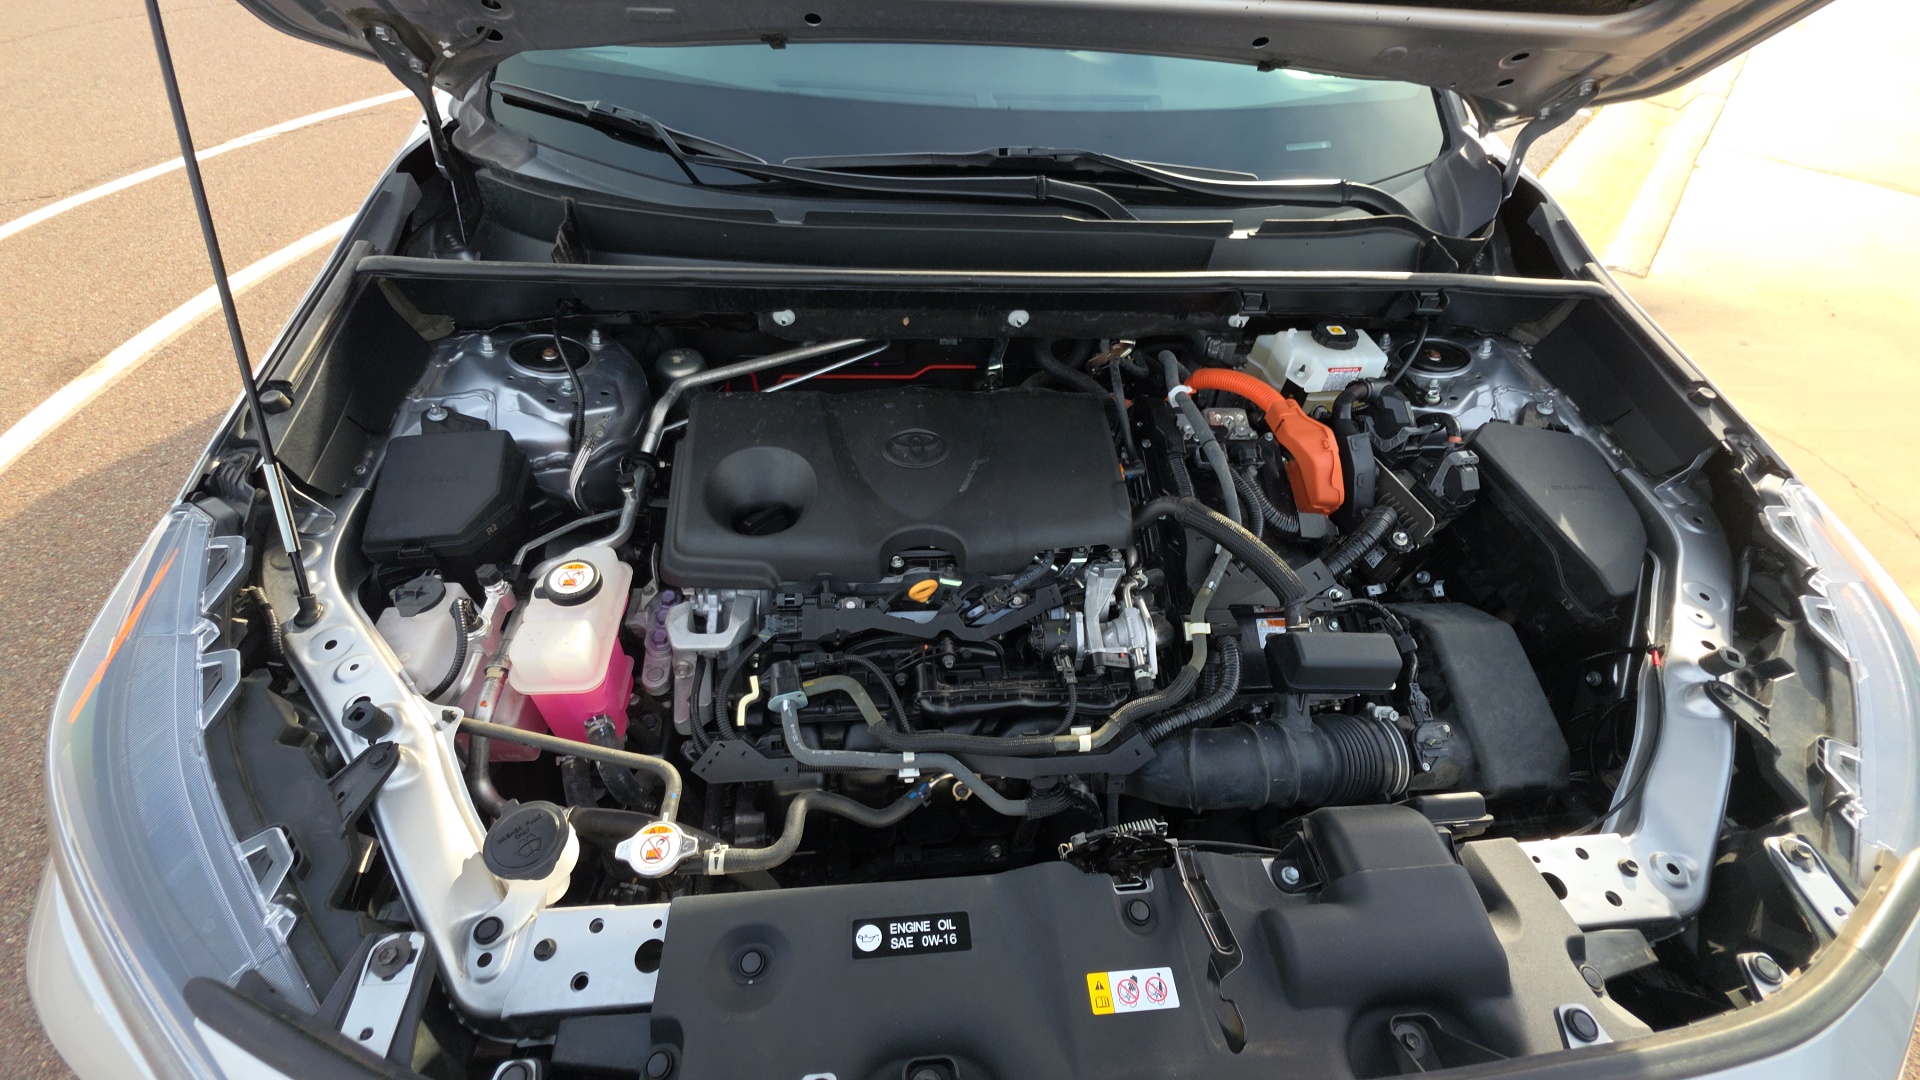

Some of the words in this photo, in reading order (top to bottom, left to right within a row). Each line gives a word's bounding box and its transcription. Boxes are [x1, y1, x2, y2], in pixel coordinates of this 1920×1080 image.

[486, 523, 499, 536] R2
[1561, 597, 1574, 610] L3
[890, 920, 931, 935] ENGINE
[937, 919, 957, 931] OIL
[890, 936, 914, 950] SAE
[921, 933, 958, 947] 0W-16
